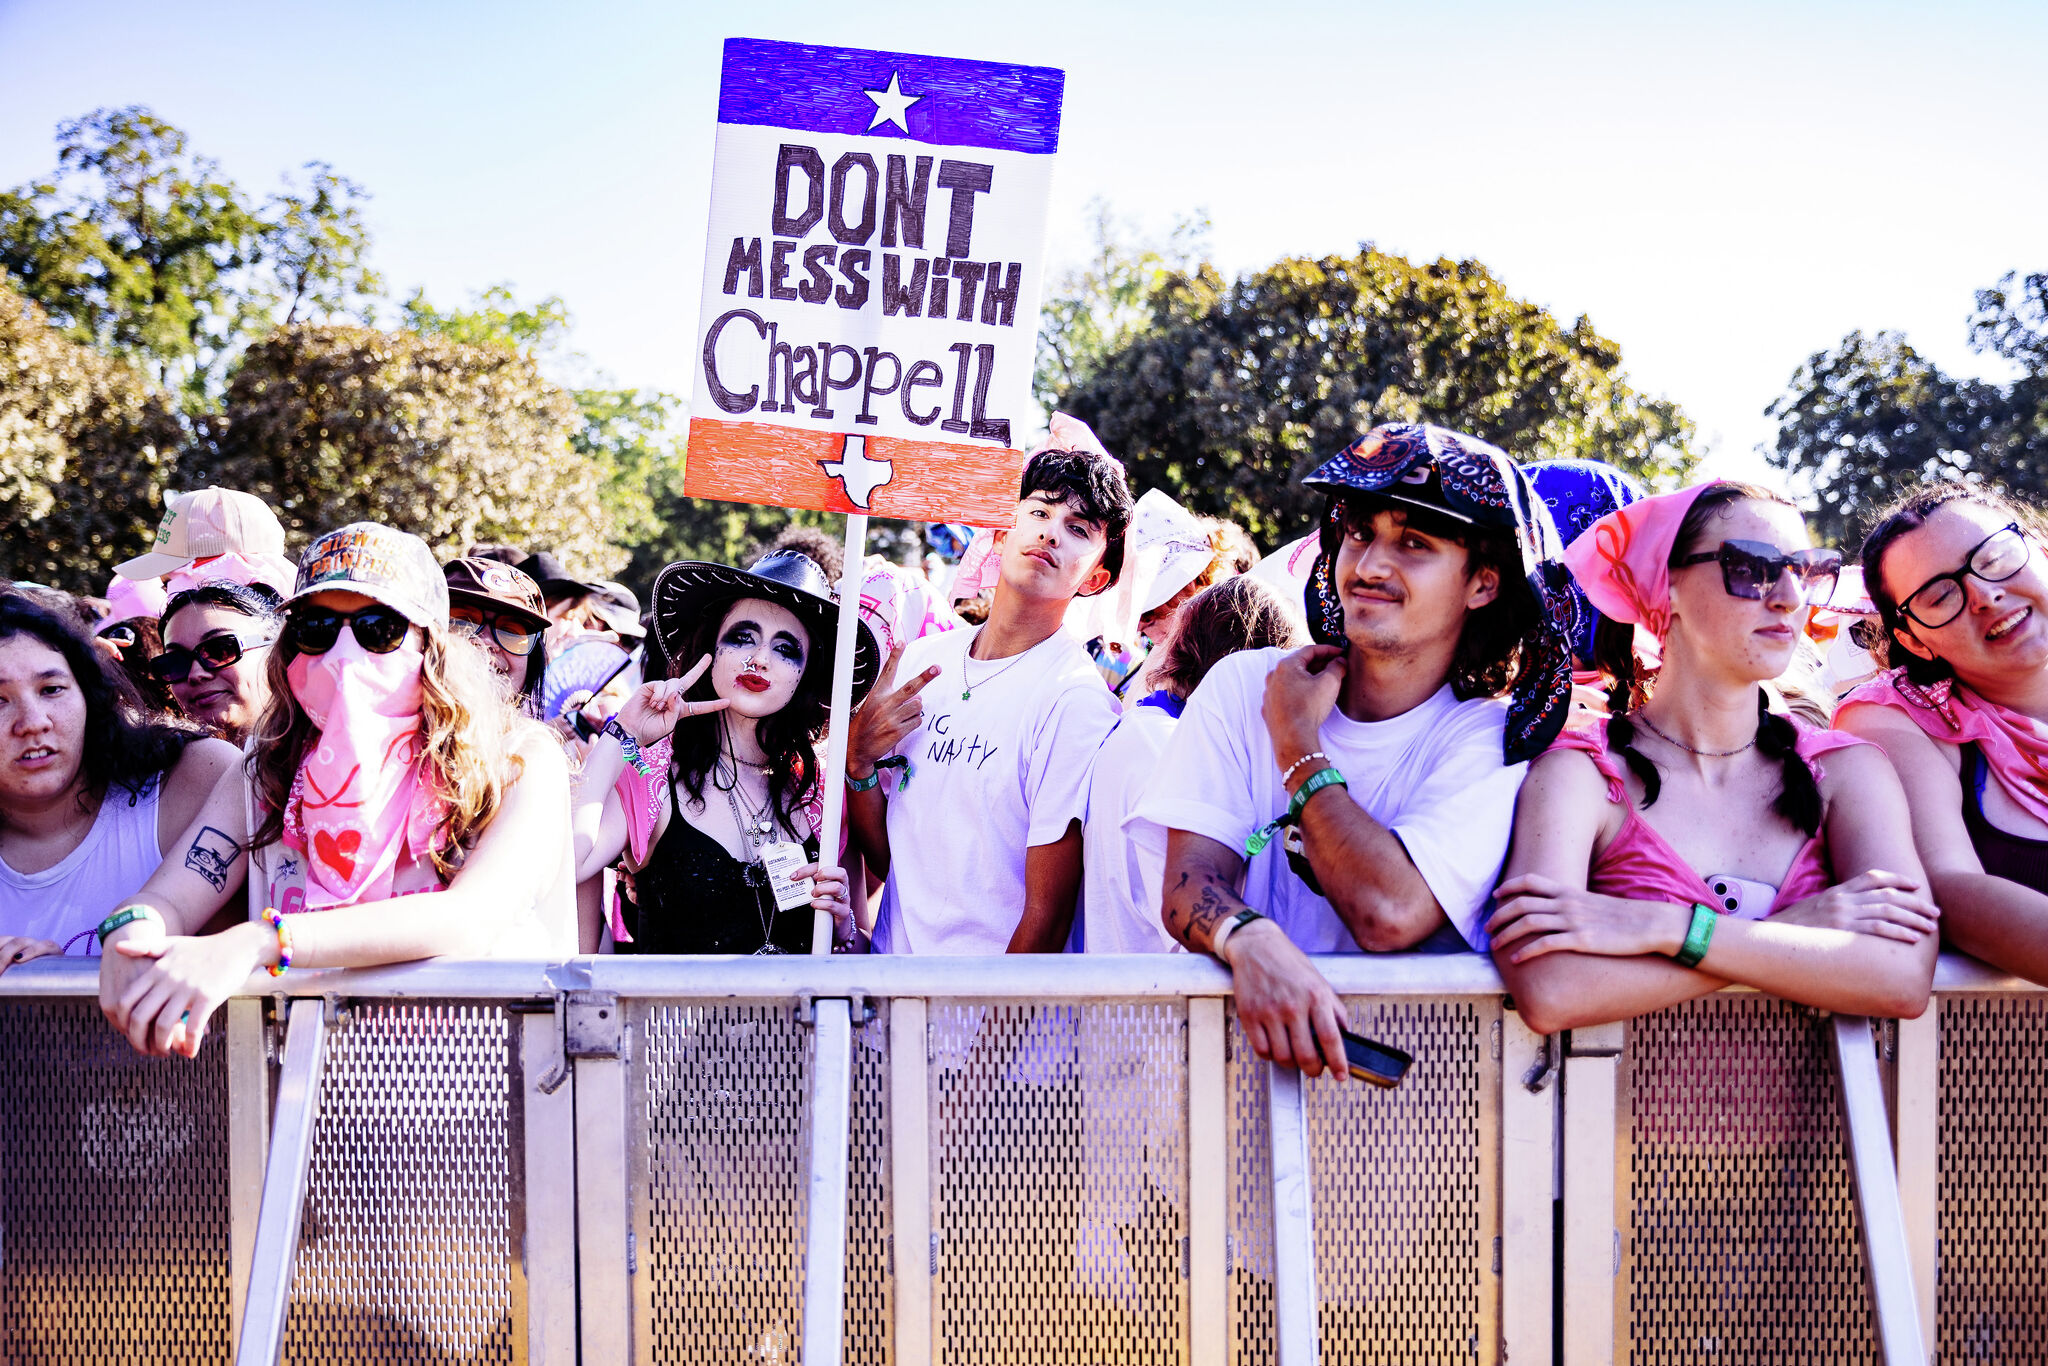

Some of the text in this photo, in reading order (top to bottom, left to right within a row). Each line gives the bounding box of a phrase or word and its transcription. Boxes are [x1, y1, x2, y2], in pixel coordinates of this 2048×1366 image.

[771, 143, 994, 259] DONT
[722, 236, 872, 311] MESS
[920, 711, 951, 735] IG
